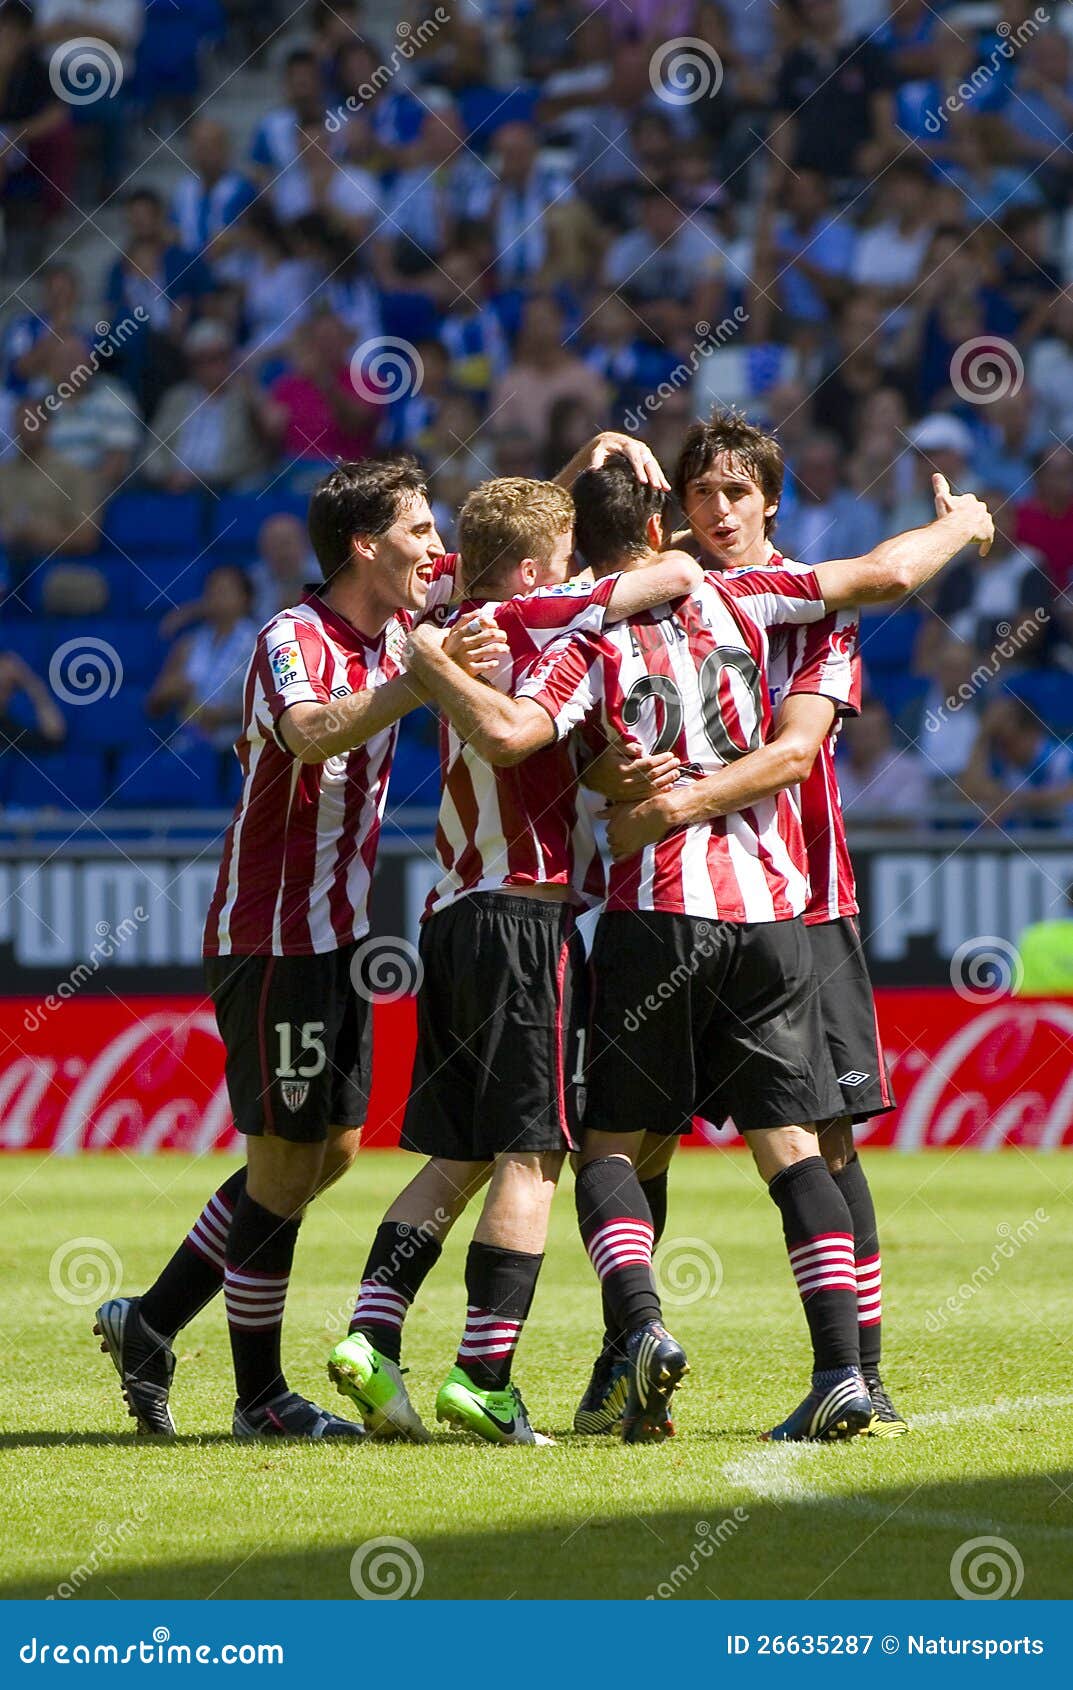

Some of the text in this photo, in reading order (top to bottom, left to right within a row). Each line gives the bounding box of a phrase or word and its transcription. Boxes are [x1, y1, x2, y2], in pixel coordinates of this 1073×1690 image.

[279, 671, 298, 687] LFP
[622, 645, 763, 774] 20
[0, 859, 220, 967] UM
[274, 1022, 326, 1078] 15
[571, 1028, 586, 1084] 1
